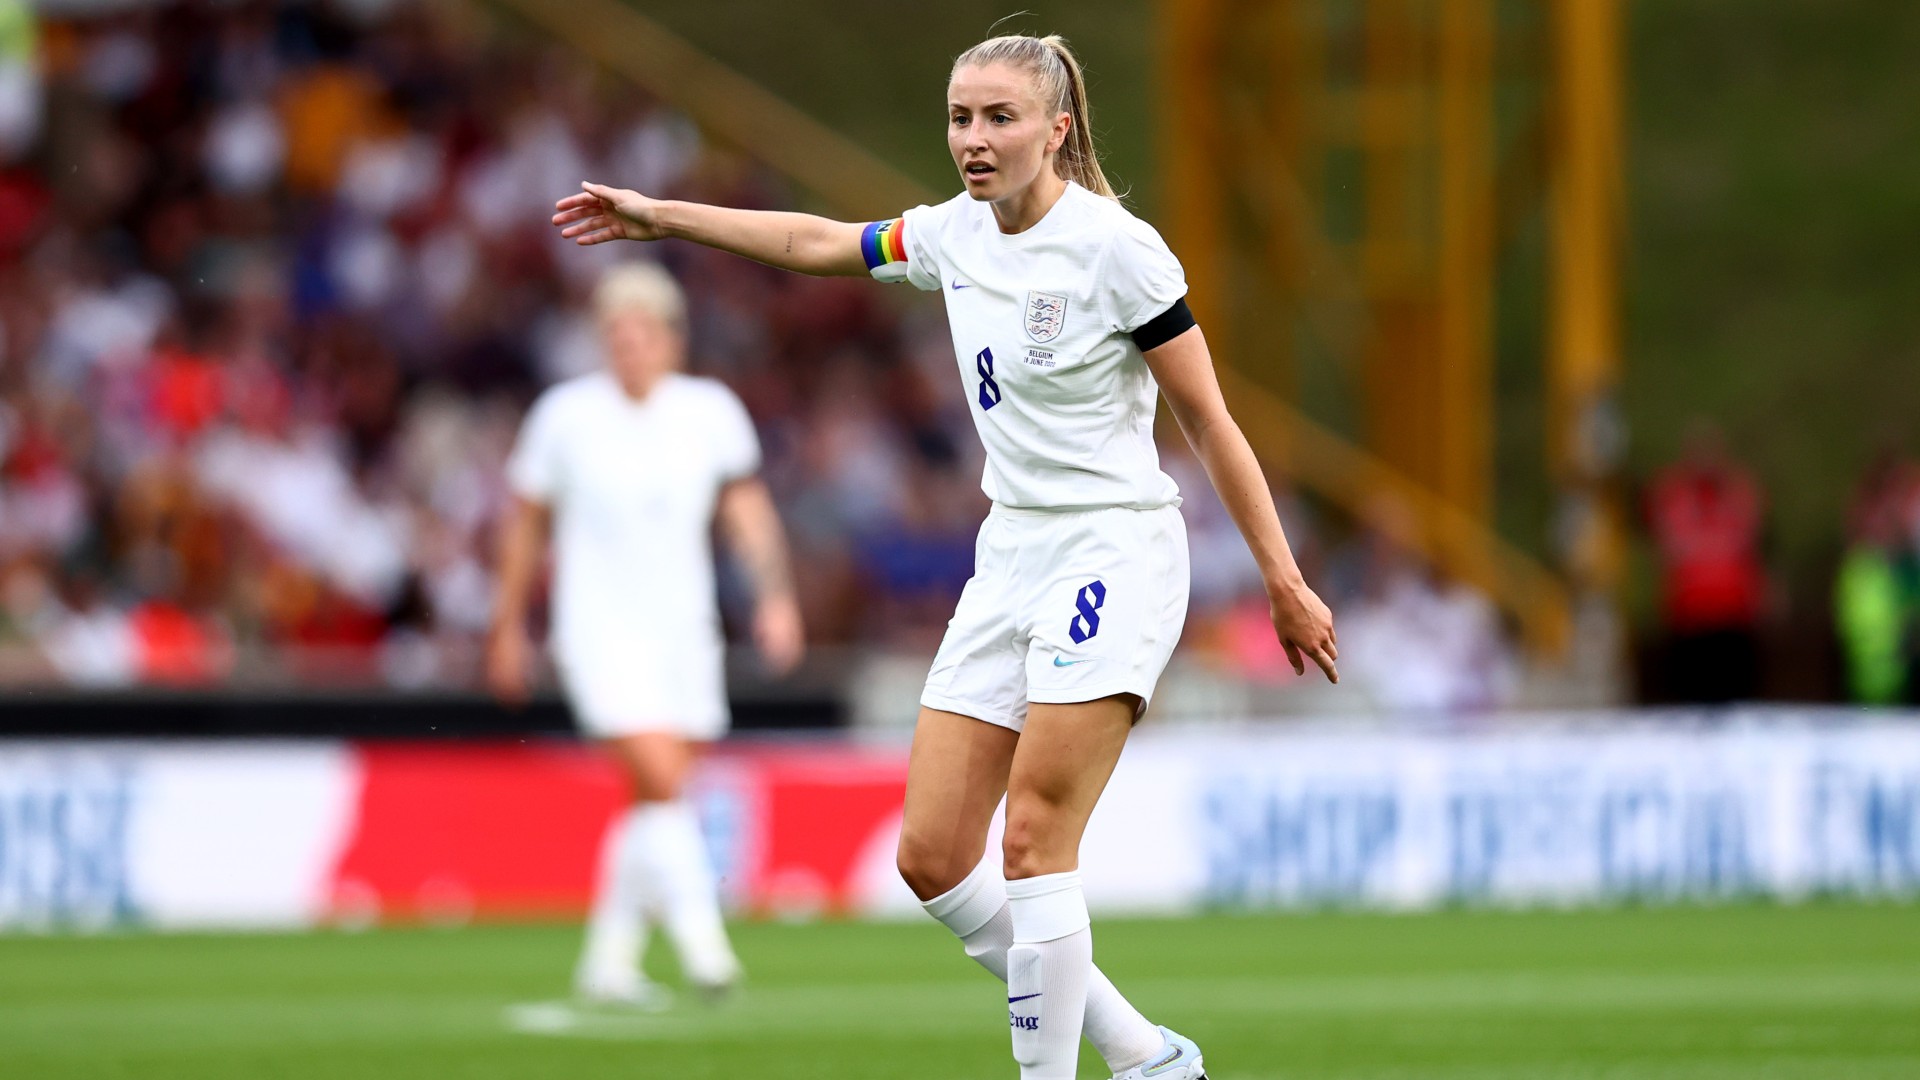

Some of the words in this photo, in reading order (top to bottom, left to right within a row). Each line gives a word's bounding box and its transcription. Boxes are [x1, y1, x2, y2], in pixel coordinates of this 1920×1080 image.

[976, 346, 1002, 412] 8
[1029, 350, 1053, 360] BELGIUM
[1030, 358, 1044, 366] JUNE
[1068, 579, 1107, 645] 8
[1200, 784, 1400, 900] SHOP
